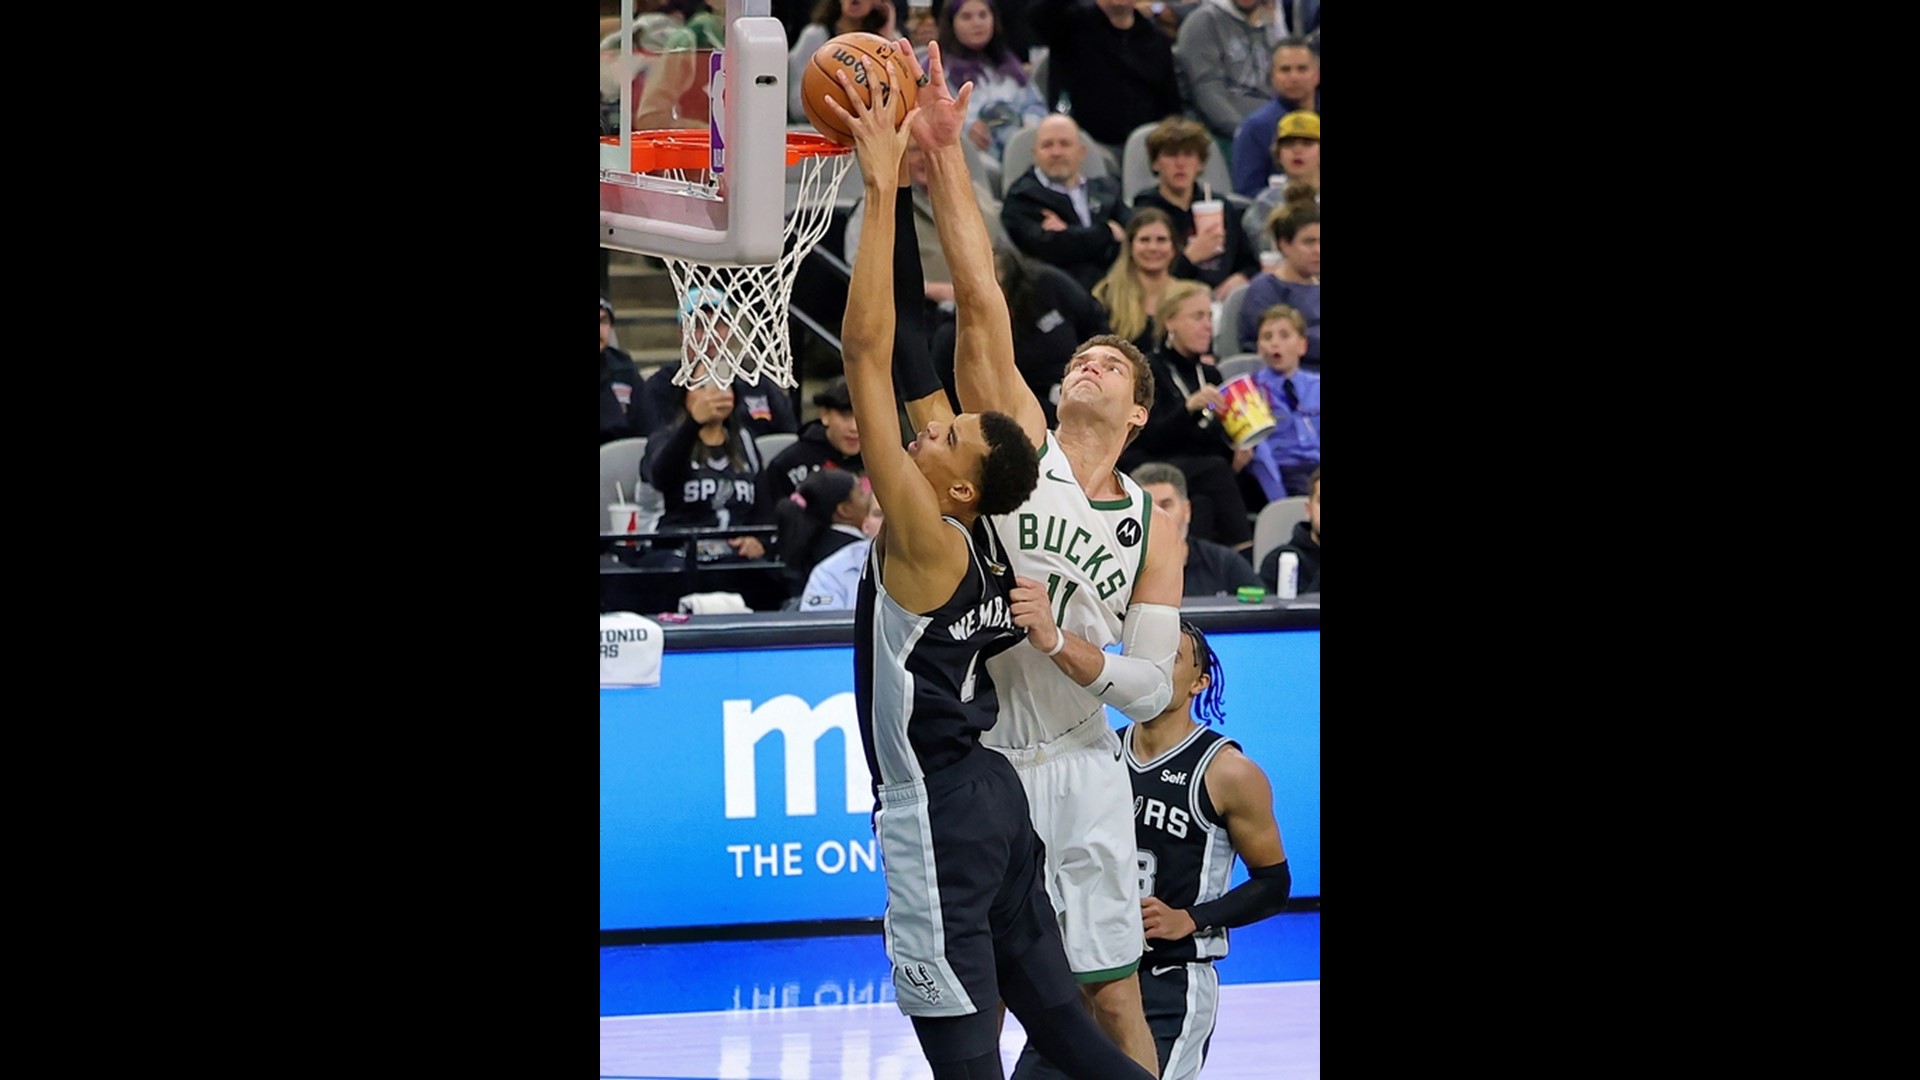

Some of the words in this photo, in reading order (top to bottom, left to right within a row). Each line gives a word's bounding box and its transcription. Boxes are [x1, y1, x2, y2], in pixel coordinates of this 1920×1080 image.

[1019, 513, 1127, 601] BUCKS
[948, 596, 1015, 641] WEMBA
[1047, 573, 1079, 629] 11
[723, 691, 877, 819] m
[1160, 769, 1188, 786] Self.
[726, 843, 803, 878] THE
[815, 839, 877, 875] ON
